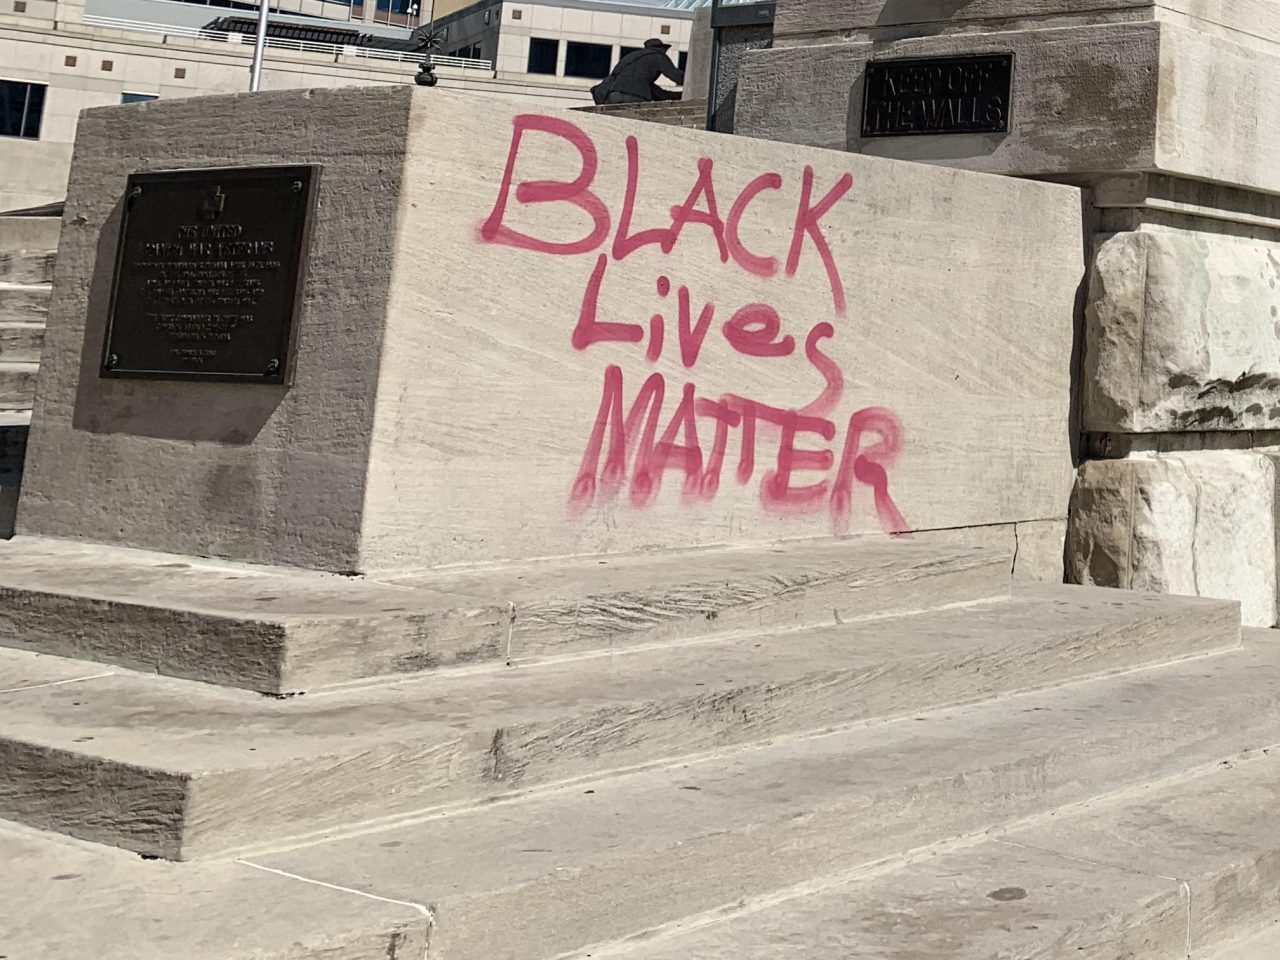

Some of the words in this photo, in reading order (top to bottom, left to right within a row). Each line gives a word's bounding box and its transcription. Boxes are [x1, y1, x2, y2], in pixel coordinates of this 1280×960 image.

[871, 99, 914, 129] THE
[922, 96, 1002, 128] WALLS
[884, 66, 942, 96] KEEP
[478, 114, 853, 318] BLACK
[568, 364, 914, 536] MATTER
